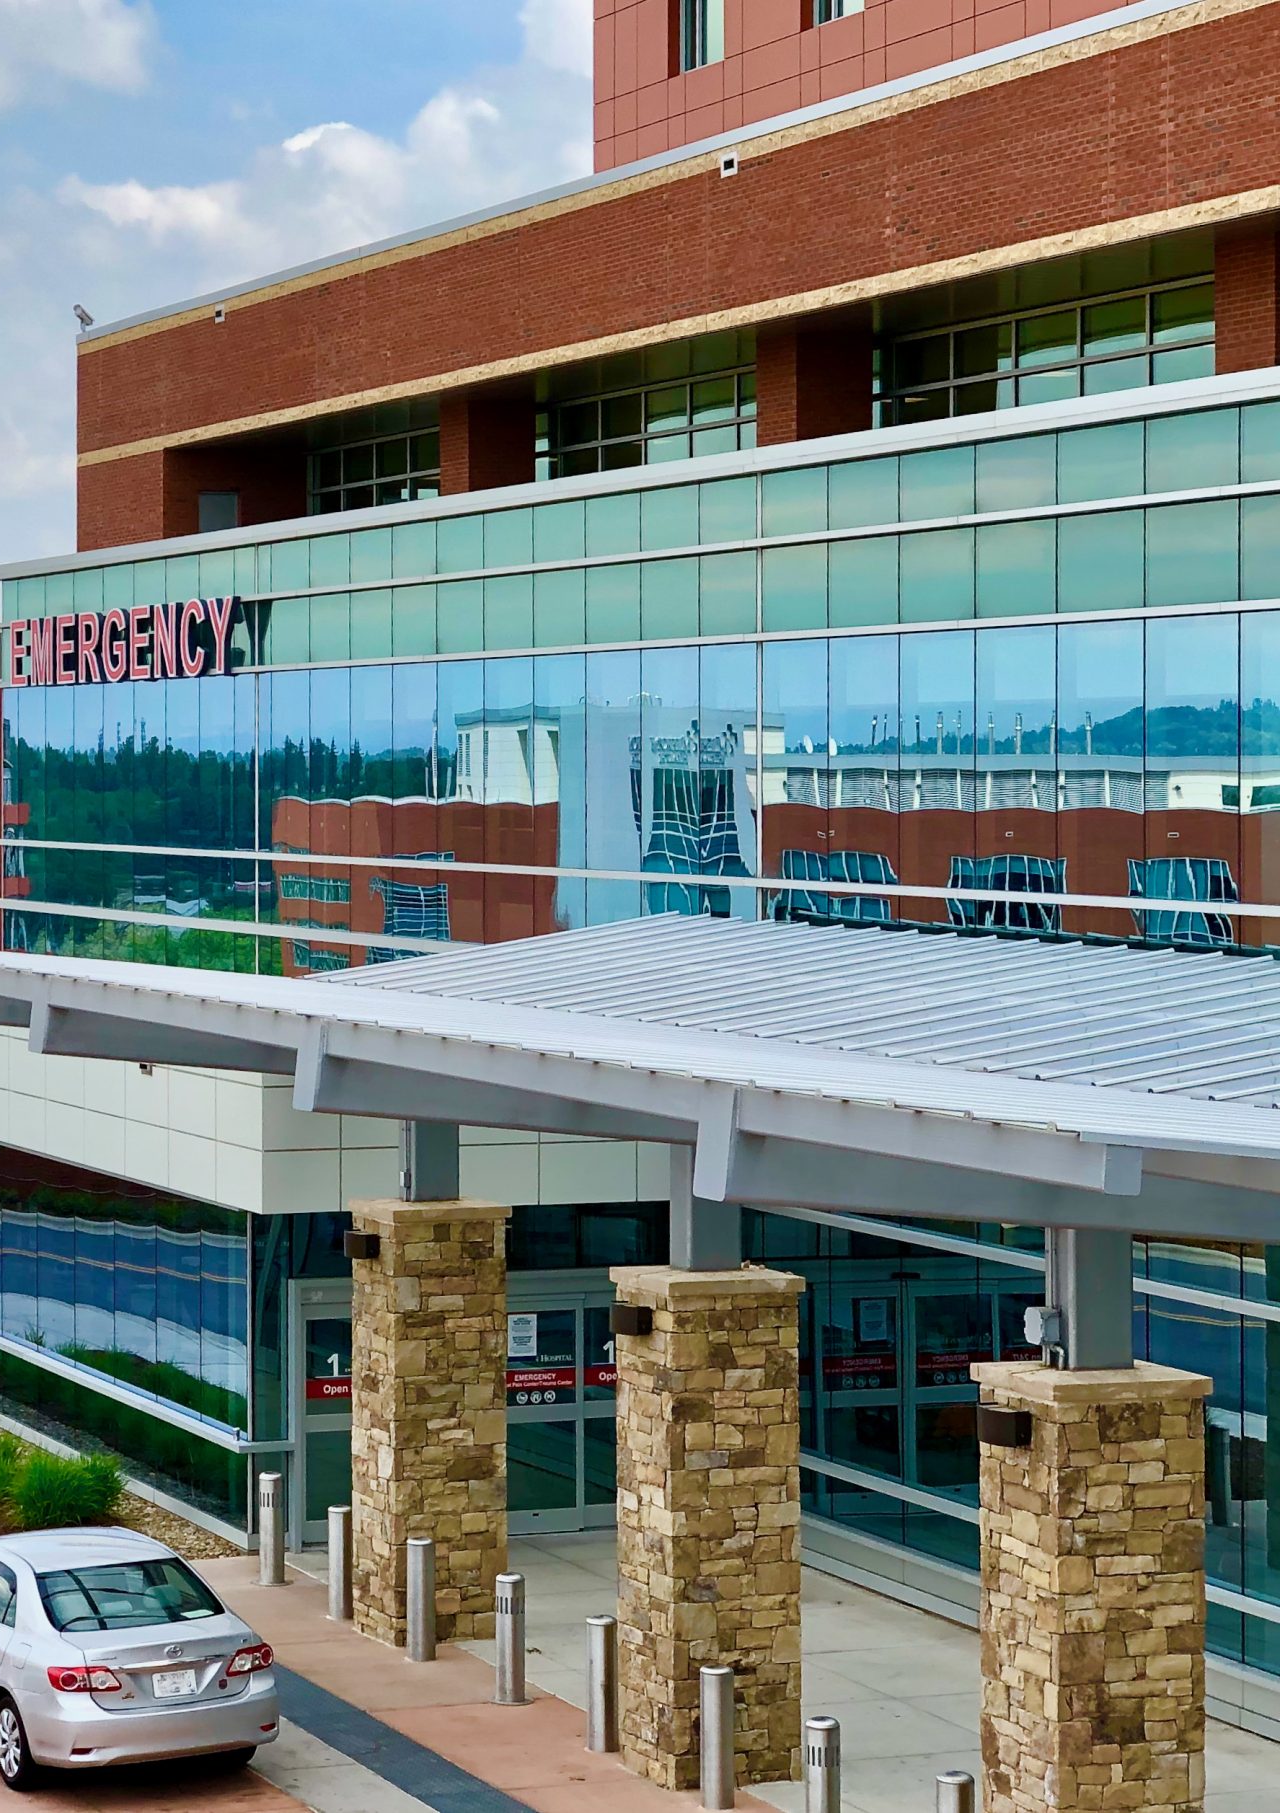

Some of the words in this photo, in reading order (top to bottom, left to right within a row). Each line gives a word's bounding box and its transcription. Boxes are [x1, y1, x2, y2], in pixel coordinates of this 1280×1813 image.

[10, 596, 236, 687] EMERGENCY
[603, 1340, 614, 1364] 1
[327, 1353, 339, 1376] 1
[514, 1373, 556, 1381] EMERGENCY
[598, 1371, 618, 1382] Ope
[323, 1384, 348, 1395] Open
